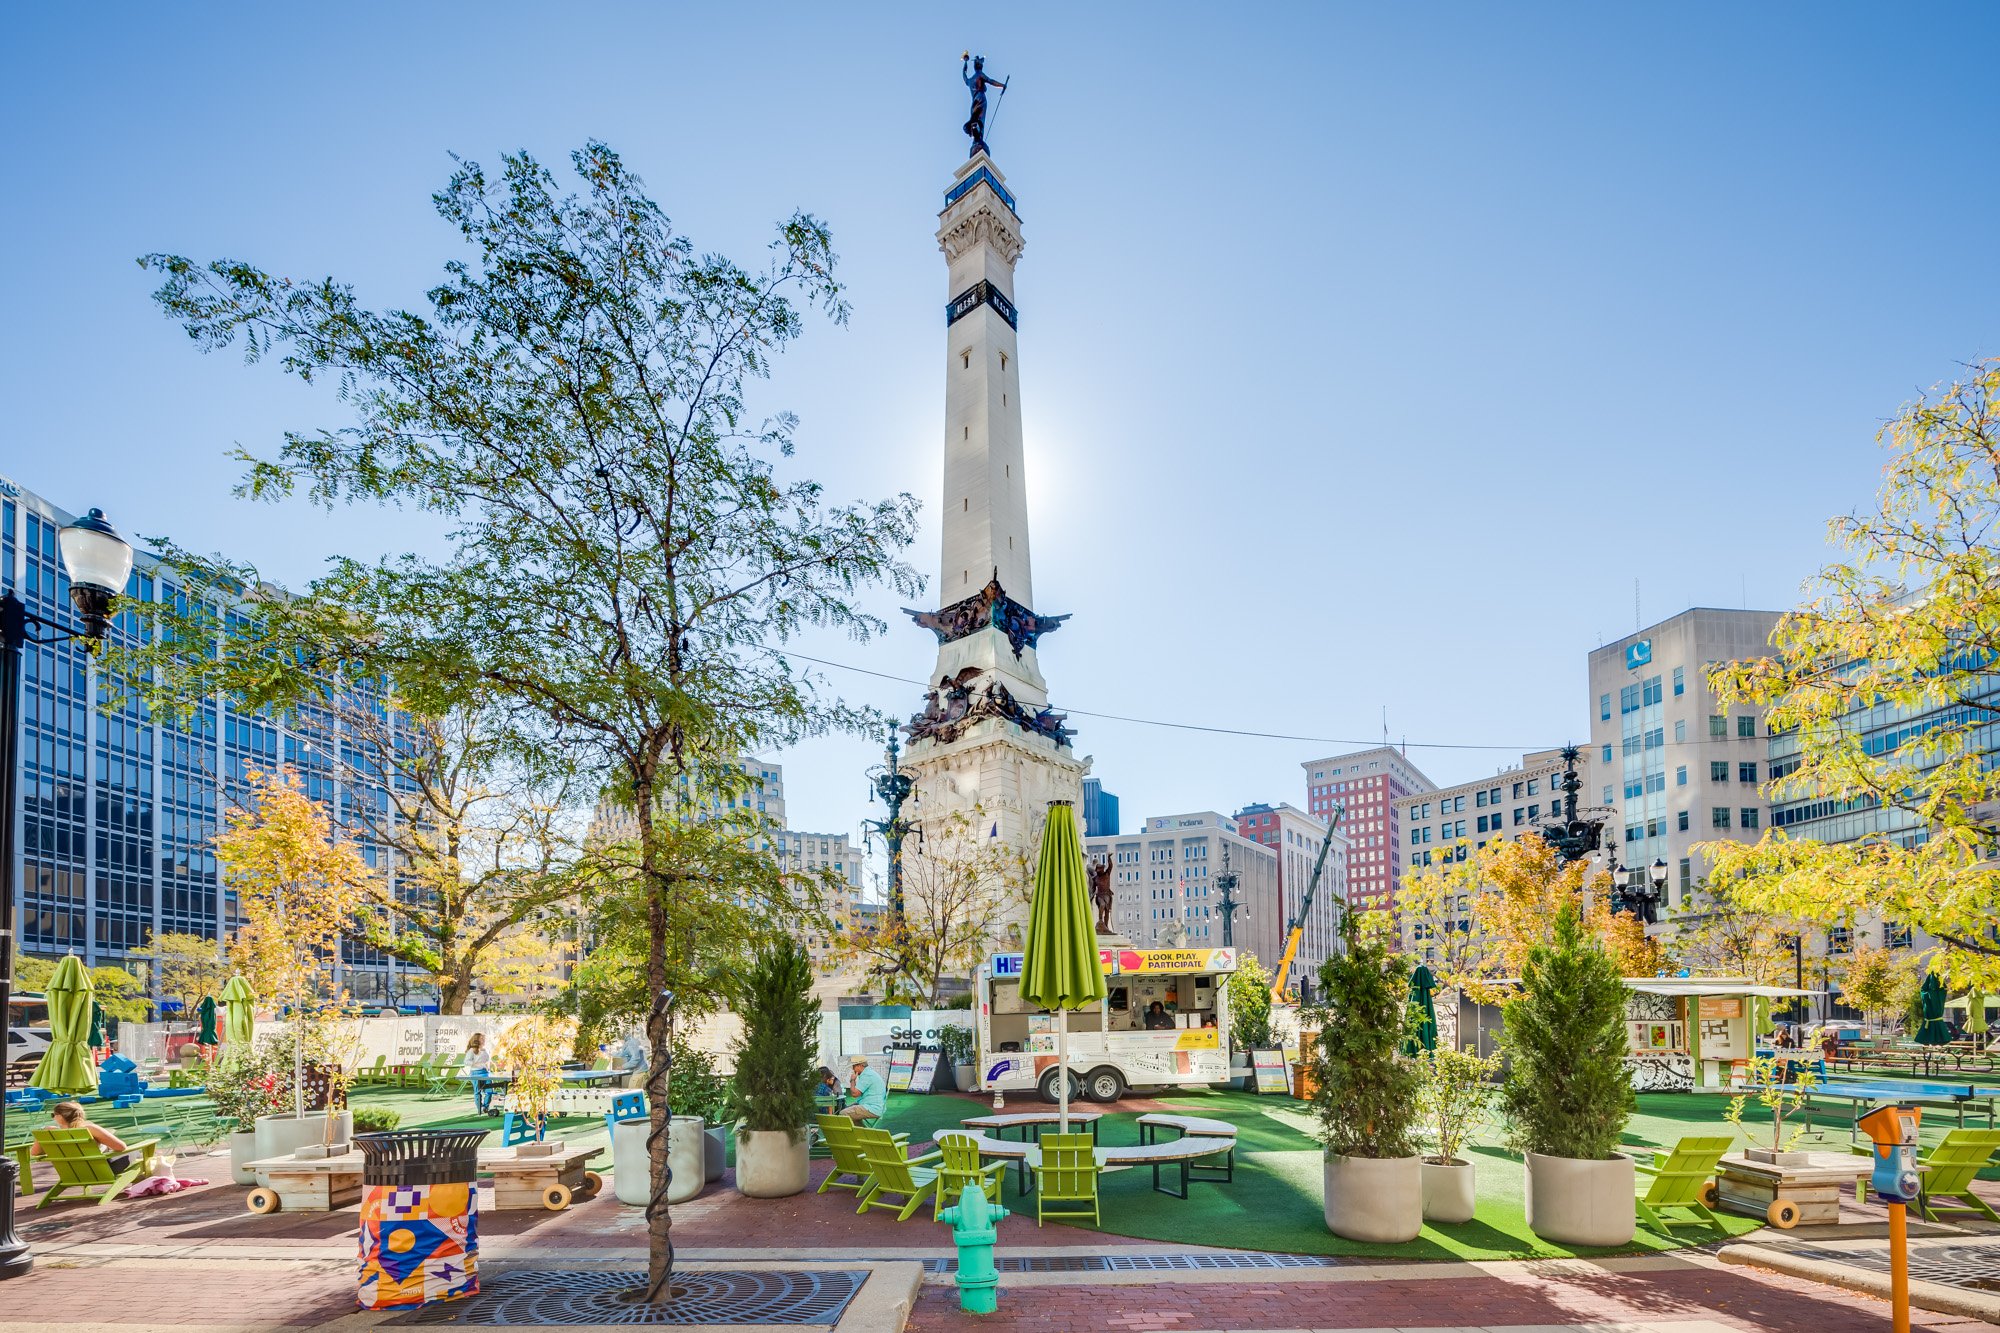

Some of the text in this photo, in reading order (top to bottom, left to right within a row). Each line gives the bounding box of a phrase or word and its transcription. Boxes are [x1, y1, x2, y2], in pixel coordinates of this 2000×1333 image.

[1179, 819, 1204, 827] Indiana
[1148, 961, 1204, 969] PARTICIPATE.
[1437, 1011, 1454, 1021] See
[404, 1029, 424, 1041] Circle
[890, 1026, 922, 1040] See
[398, 1045, 423, 1055] around
